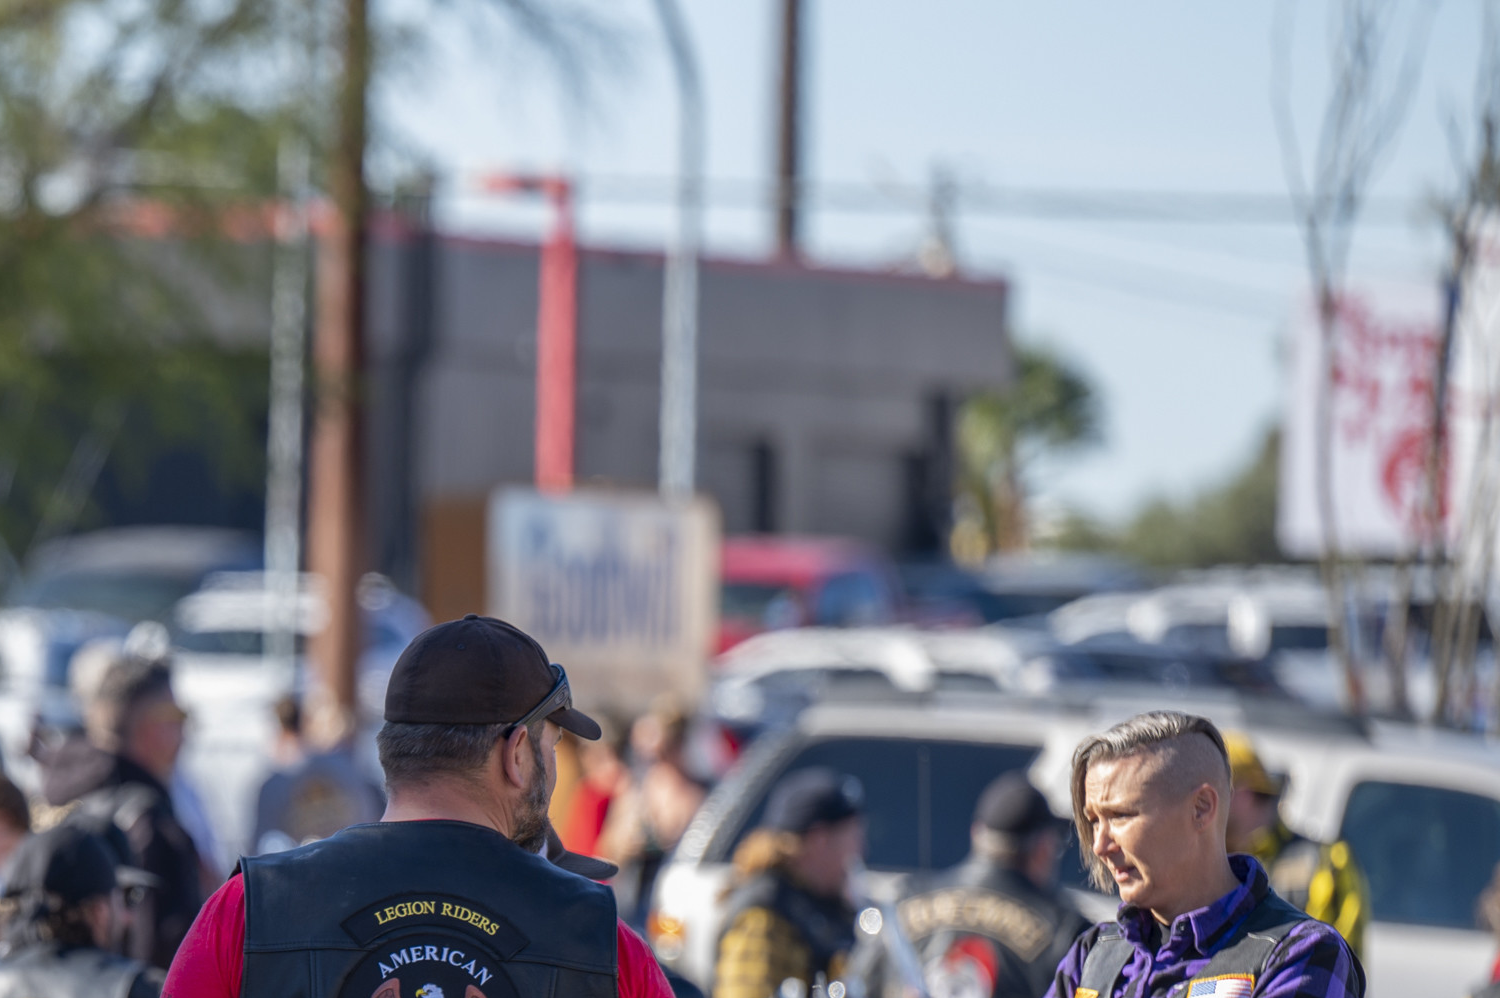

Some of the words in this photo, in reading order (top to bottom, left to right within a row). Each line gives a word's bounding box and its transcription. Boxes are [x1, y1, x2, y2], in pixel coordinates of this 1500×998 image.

[374, 901, 436, 925] LEGION
[441, 902, 500, 936] RIDERS
[377, 945, 493, 986] AMERICAN
